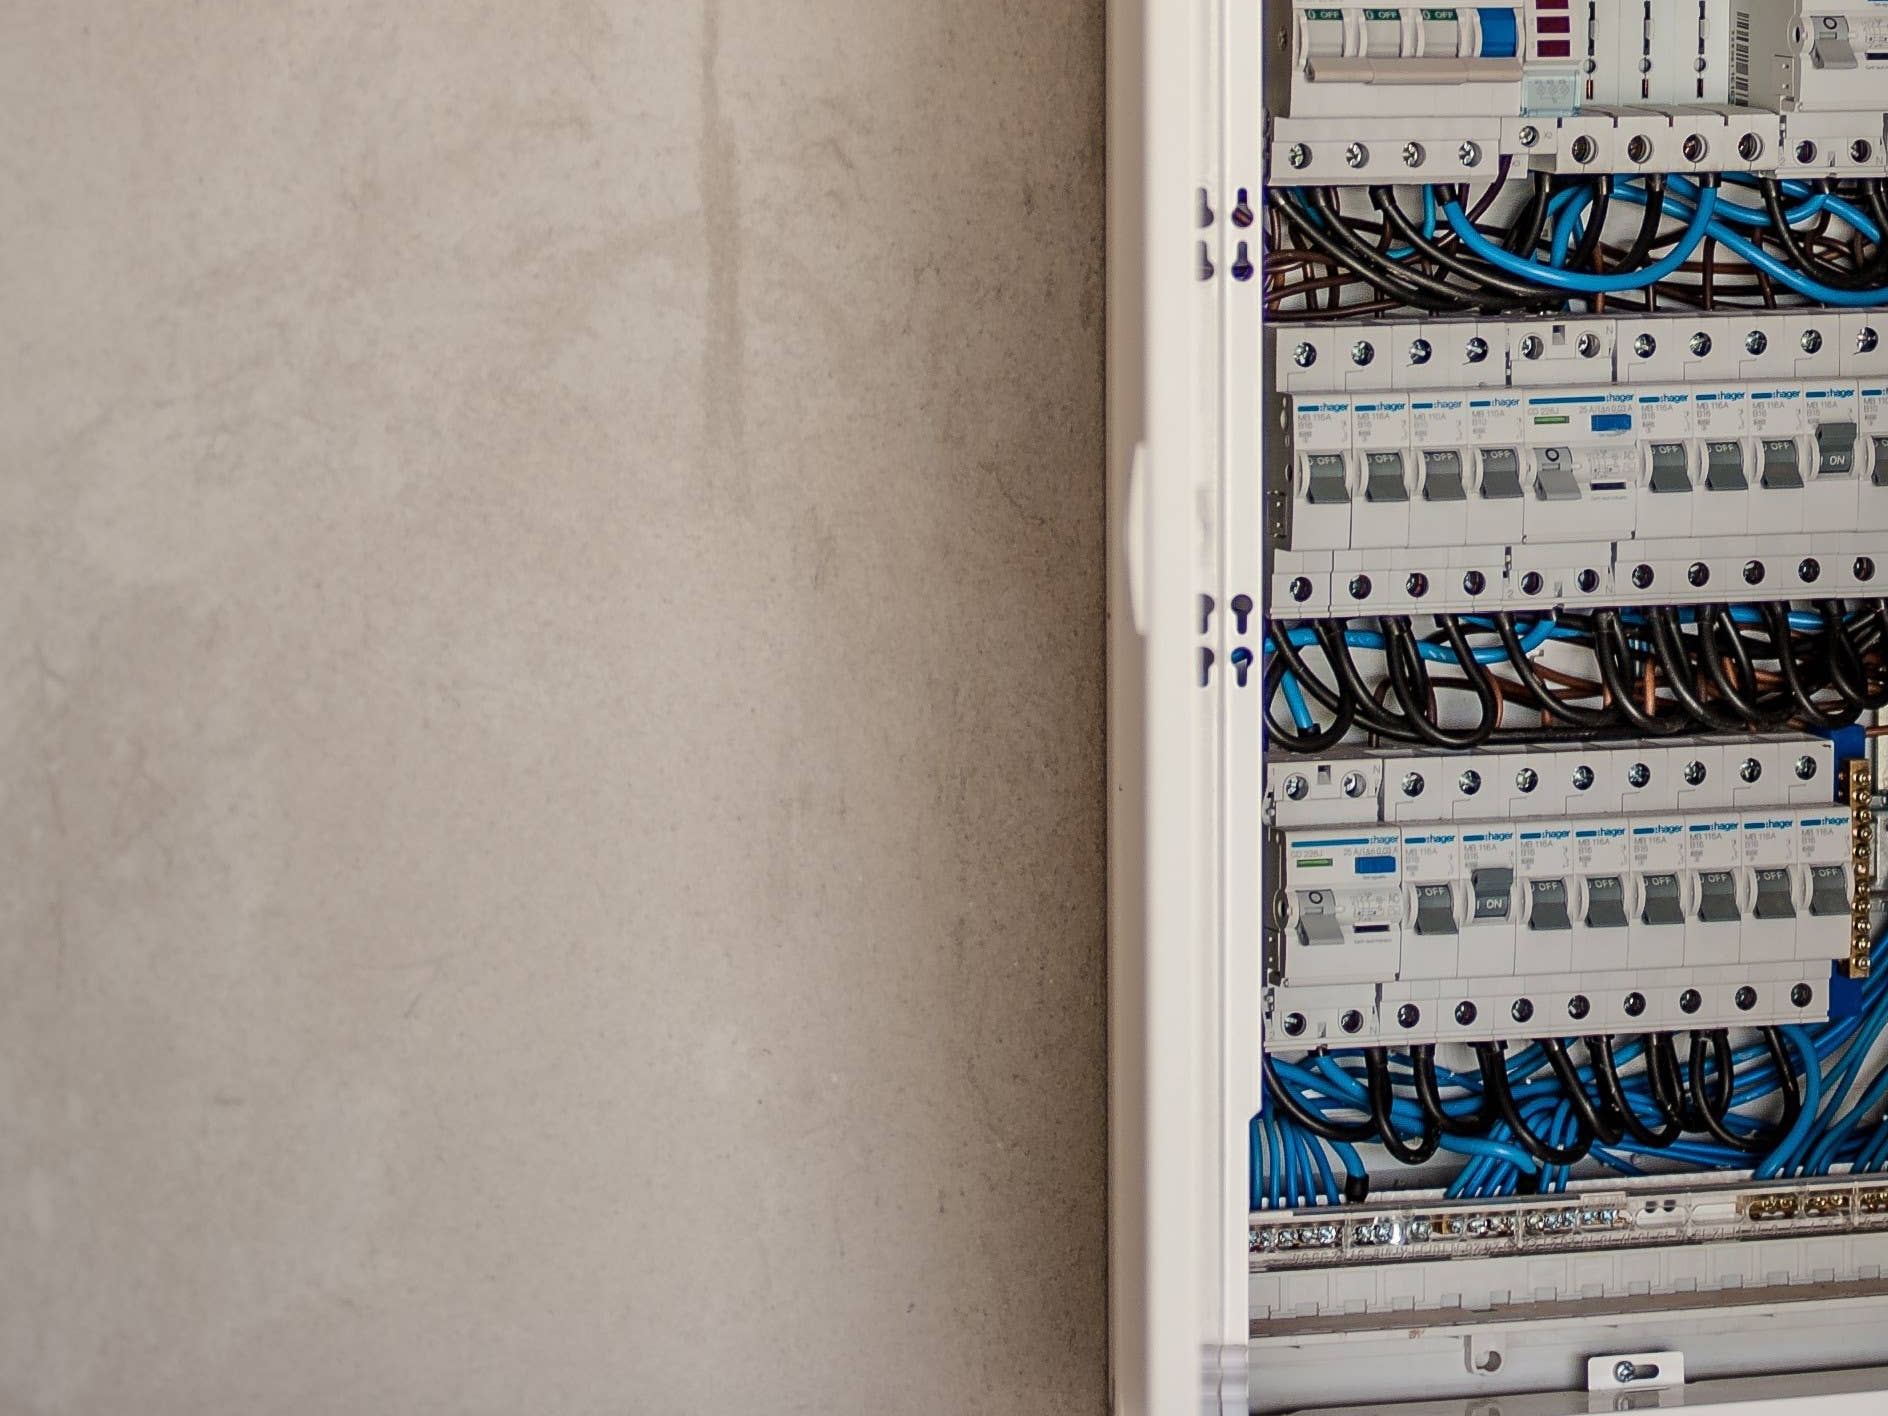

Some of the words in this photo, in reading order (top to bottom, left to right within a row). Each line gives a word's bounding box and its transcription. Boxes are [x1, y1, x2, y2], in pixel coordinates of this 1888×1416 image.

[1660, 446, 1678, 454] OFF
[1716, 444, 1735, 452] OFF
[1433, 454, 1453, 462] OFF
[1490, 450, 1510, 458] OFF
[1376, 455, 1394, 463] OFF
[1830, 456, 1845, 466] ON
[1764, 872, 1783, 880] OFF
[1819, 868, 1839, 877] OFF
[1652, 878, 1671, 886] OFF
[1708, 874, 1728, 882] OFF
[1538, 883, 1558, 892] OFF
[1596, 880, 1615, 888] OFF
[1424, 888, 1444, 896] OFF
[1486, 899, 1502, 909] ON
